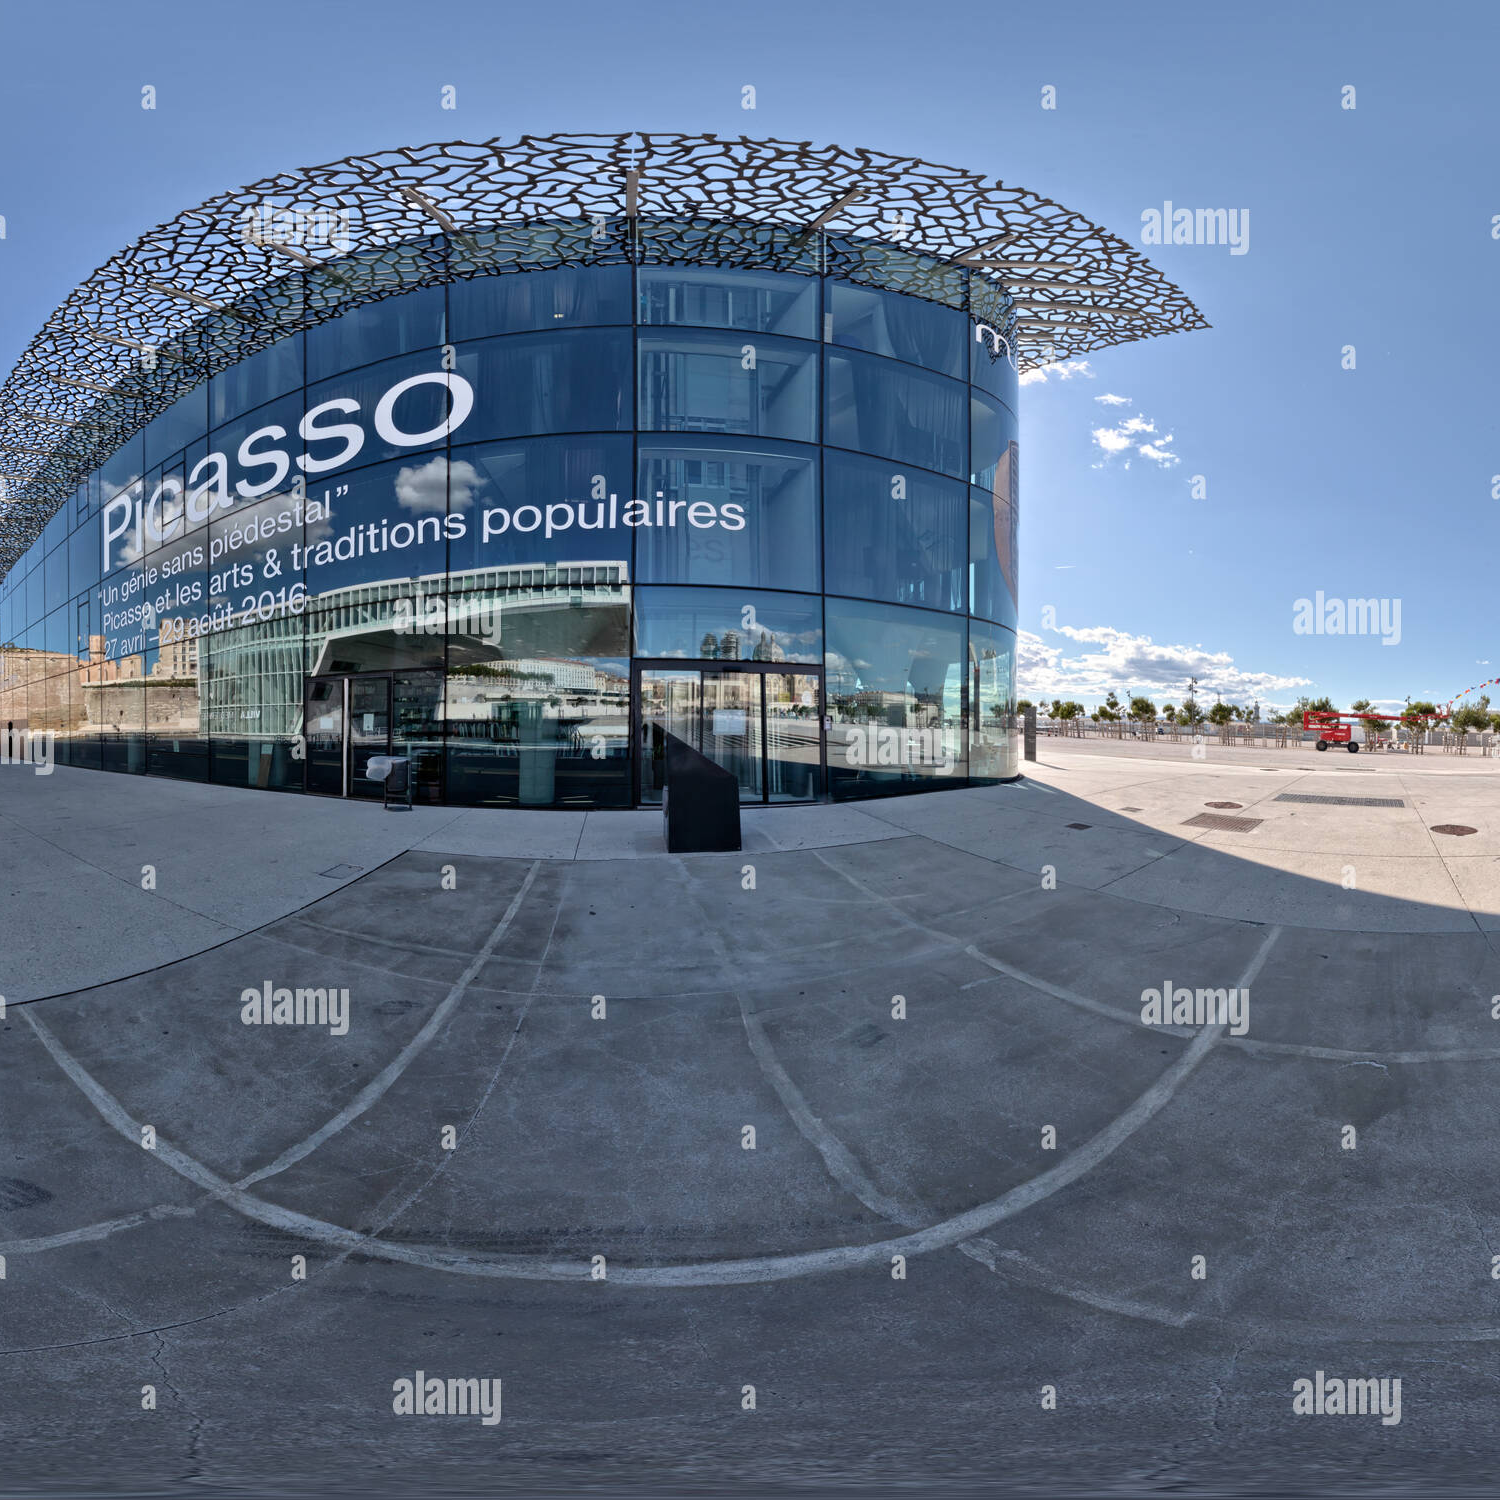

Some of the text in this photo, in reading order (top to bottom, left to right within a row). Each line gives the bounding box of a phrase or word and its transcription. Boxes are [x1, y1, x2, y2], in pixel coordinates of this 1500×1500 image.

[103, 372, 474, 573] Picasso
[103, 491, 746, 634] Picasso et les arts & traditions populaires
[121, 566, 158, 602] génie
[162, 547, 203, 579] sans
[104, 638, 118, 660] 27
[121, 627, 146, 656] avril
[162, 616, 184, 644] 29
[188, 602, 234, 638] août
[241, 582, 307, 625] 2016
